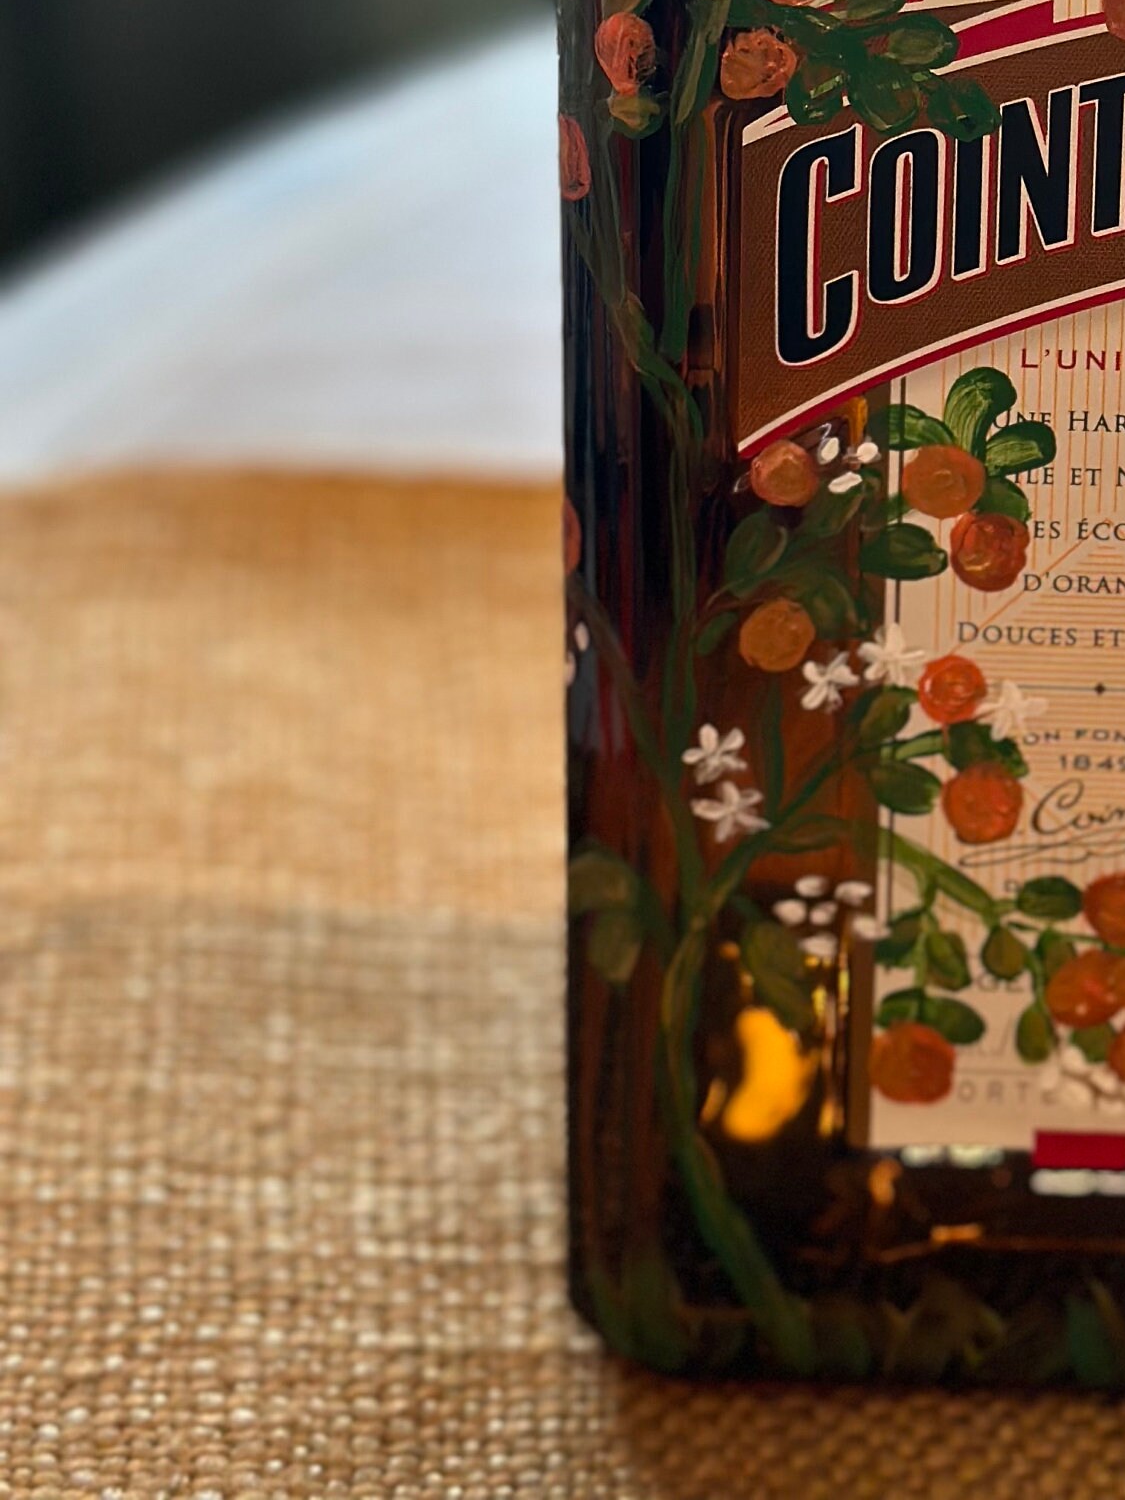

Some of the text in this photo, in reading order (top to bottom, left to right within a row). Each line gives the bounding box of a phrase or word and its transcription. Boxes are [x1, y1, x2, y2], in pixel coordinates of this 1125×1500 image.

[1069, 467, 1103, 487] ET
[1034, 520, 1062, 540] ES
[957, 621, 1078, 646] DOUCES
[1093, 628, 1125, 648] ET
